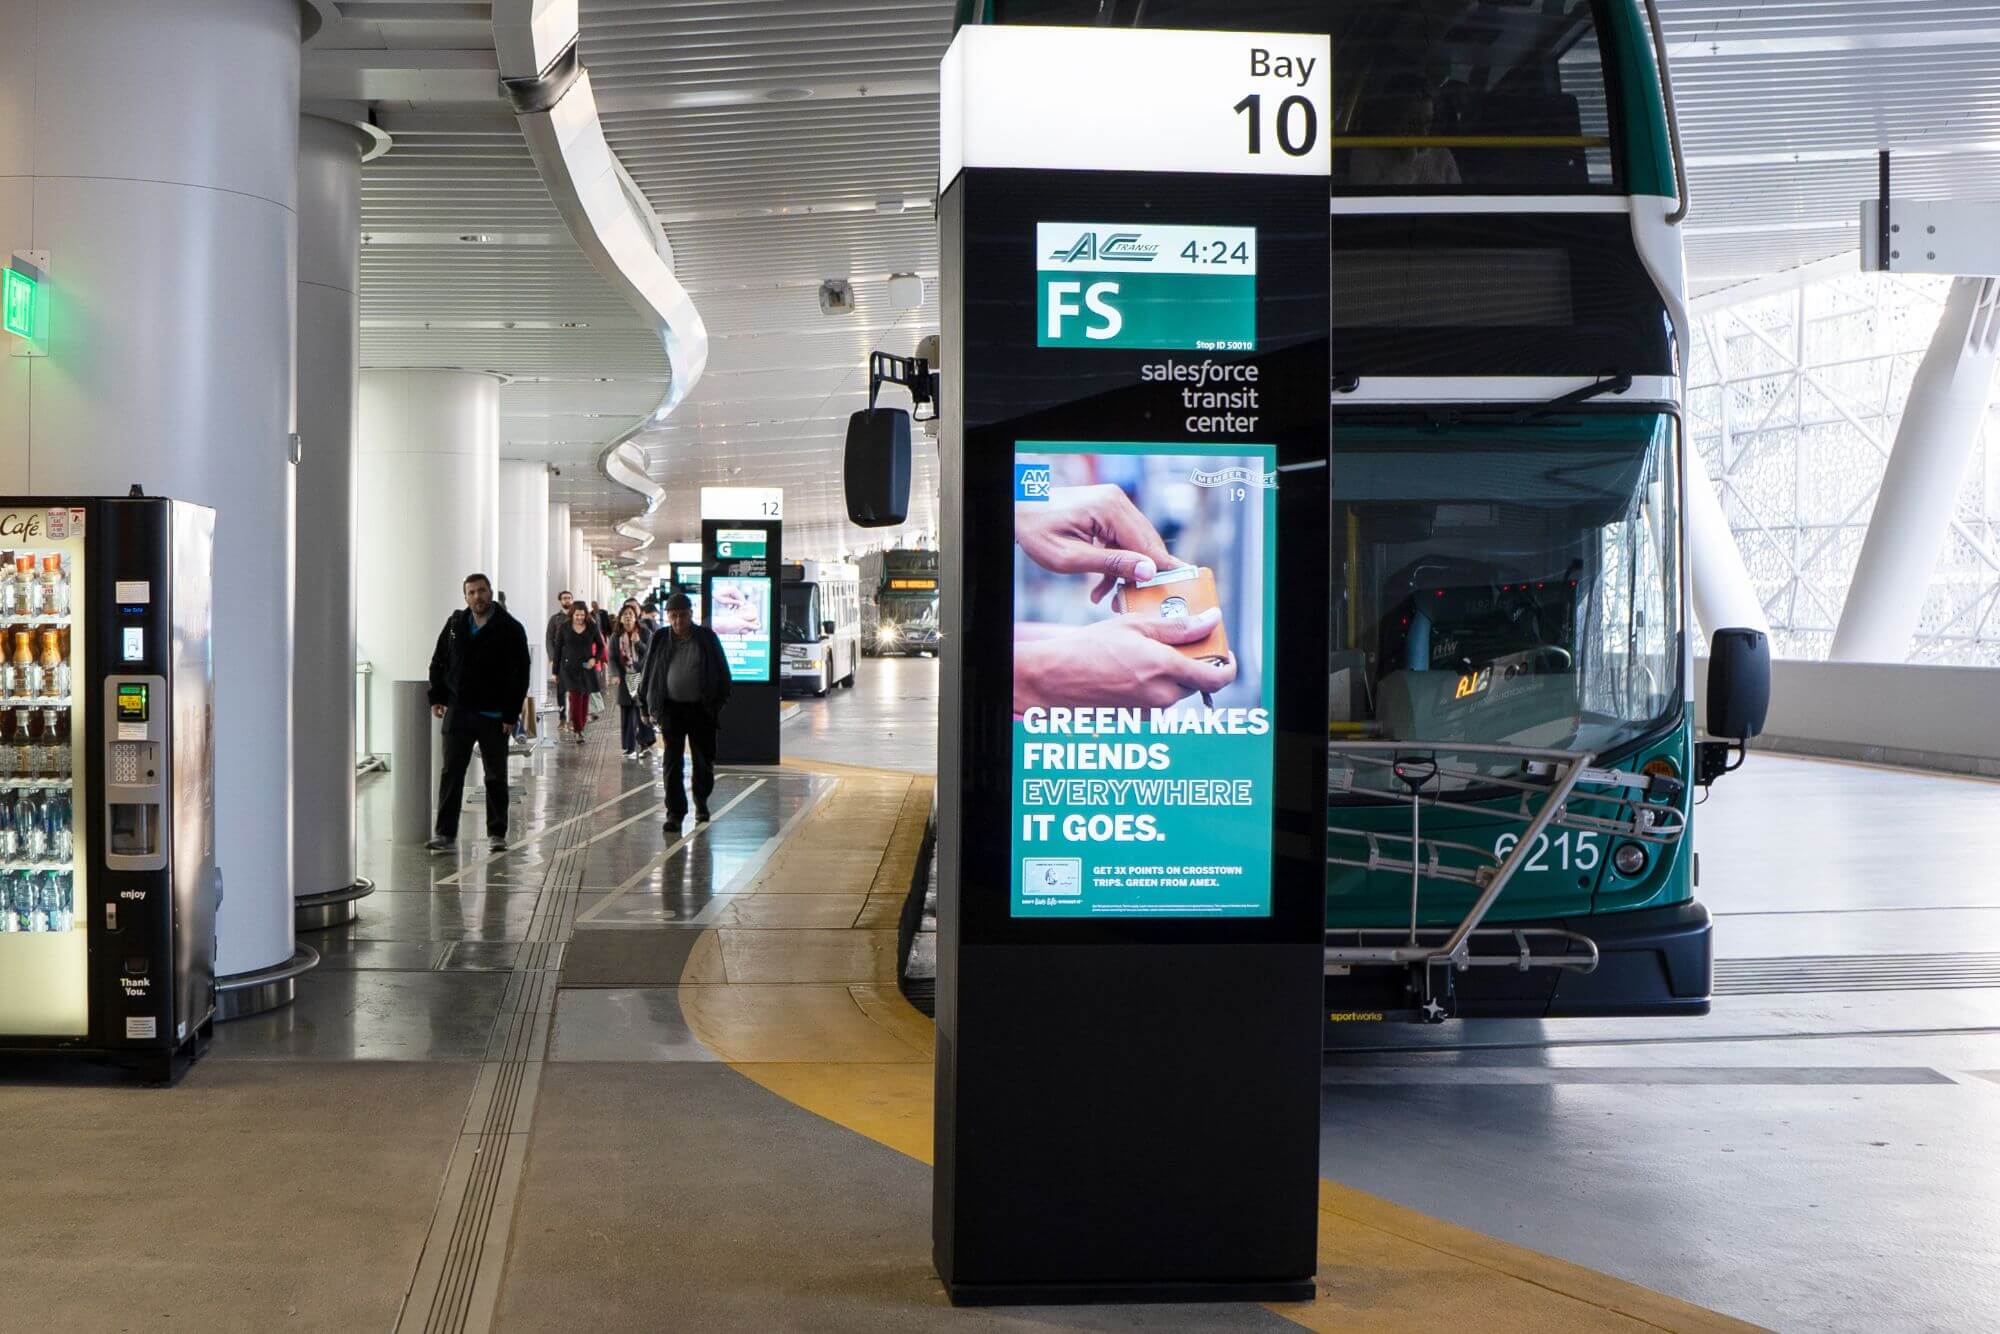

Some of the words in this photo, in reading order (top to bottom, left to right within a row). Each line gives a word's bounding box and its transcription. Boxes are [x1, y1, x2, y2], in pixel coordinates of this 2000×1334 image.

[1250, 48, 1316, 87] Bay
[1233, 94, 1318, 157] 10
[1050, 233, 1157, 262] AC
[1115, 243, 1160, 252] TRANSIT
[1180, 240, 1249, 265] 4:24
[1047, 281, 1123, 340] FS
[1196, 340, 1216, 351] Stop
[1216, 341, 1226, 350] ID
[1227, 341, 1253, 350] 50010
[1141, 359, 1259, 387] salesforce
[1182, 386, 1259, 410] transit
[1185, 411, 1259, 433] center
[1023, 469, 1050, 483] AM
[1197, 471, 1242, 484] MEMBER
[1026, 483, 1049, 496] EX
[1229, 487, 1246, 502] 19
[762, 502, 779, 516] 12
[0, 513, 40, 543] Café
[719, 543, 732, 557] G
[1022, 706, 1142, 735] GREEN
[1150, 707, 1270, 735] MAKES
[1023, 742, 1170, 771] FRIENDS
[1022, 778, 1252, 806] EVERYWHERE
[1022, 815, 1055, 841] IT
[1062, 813, 1166, 842] GOES.
[1494, 830, 1599, 872] 6215
[1093, 866, 1112, 875] GET
[1113, 866, 1127, 875] 3X
[1128, 866, 1165, 875] POINTS
[1166, 866, 1181, 875] ON
[1182, 866, 1243, 875] CROSSTOWN
[1093, 878, 1124, 888] TRIPS.
[1125, 878, 1159, 887] GREEN
[1160, 878, 1188, 887] FROM
[1189, 878, 1220, 887] AMEX.
[120, 888, 146, 900] enjoy
[120, 978, 150, 987] Thank
[125, 987, 146, 996] You.
[1330, 1011, 1383, 1022] sportworks
